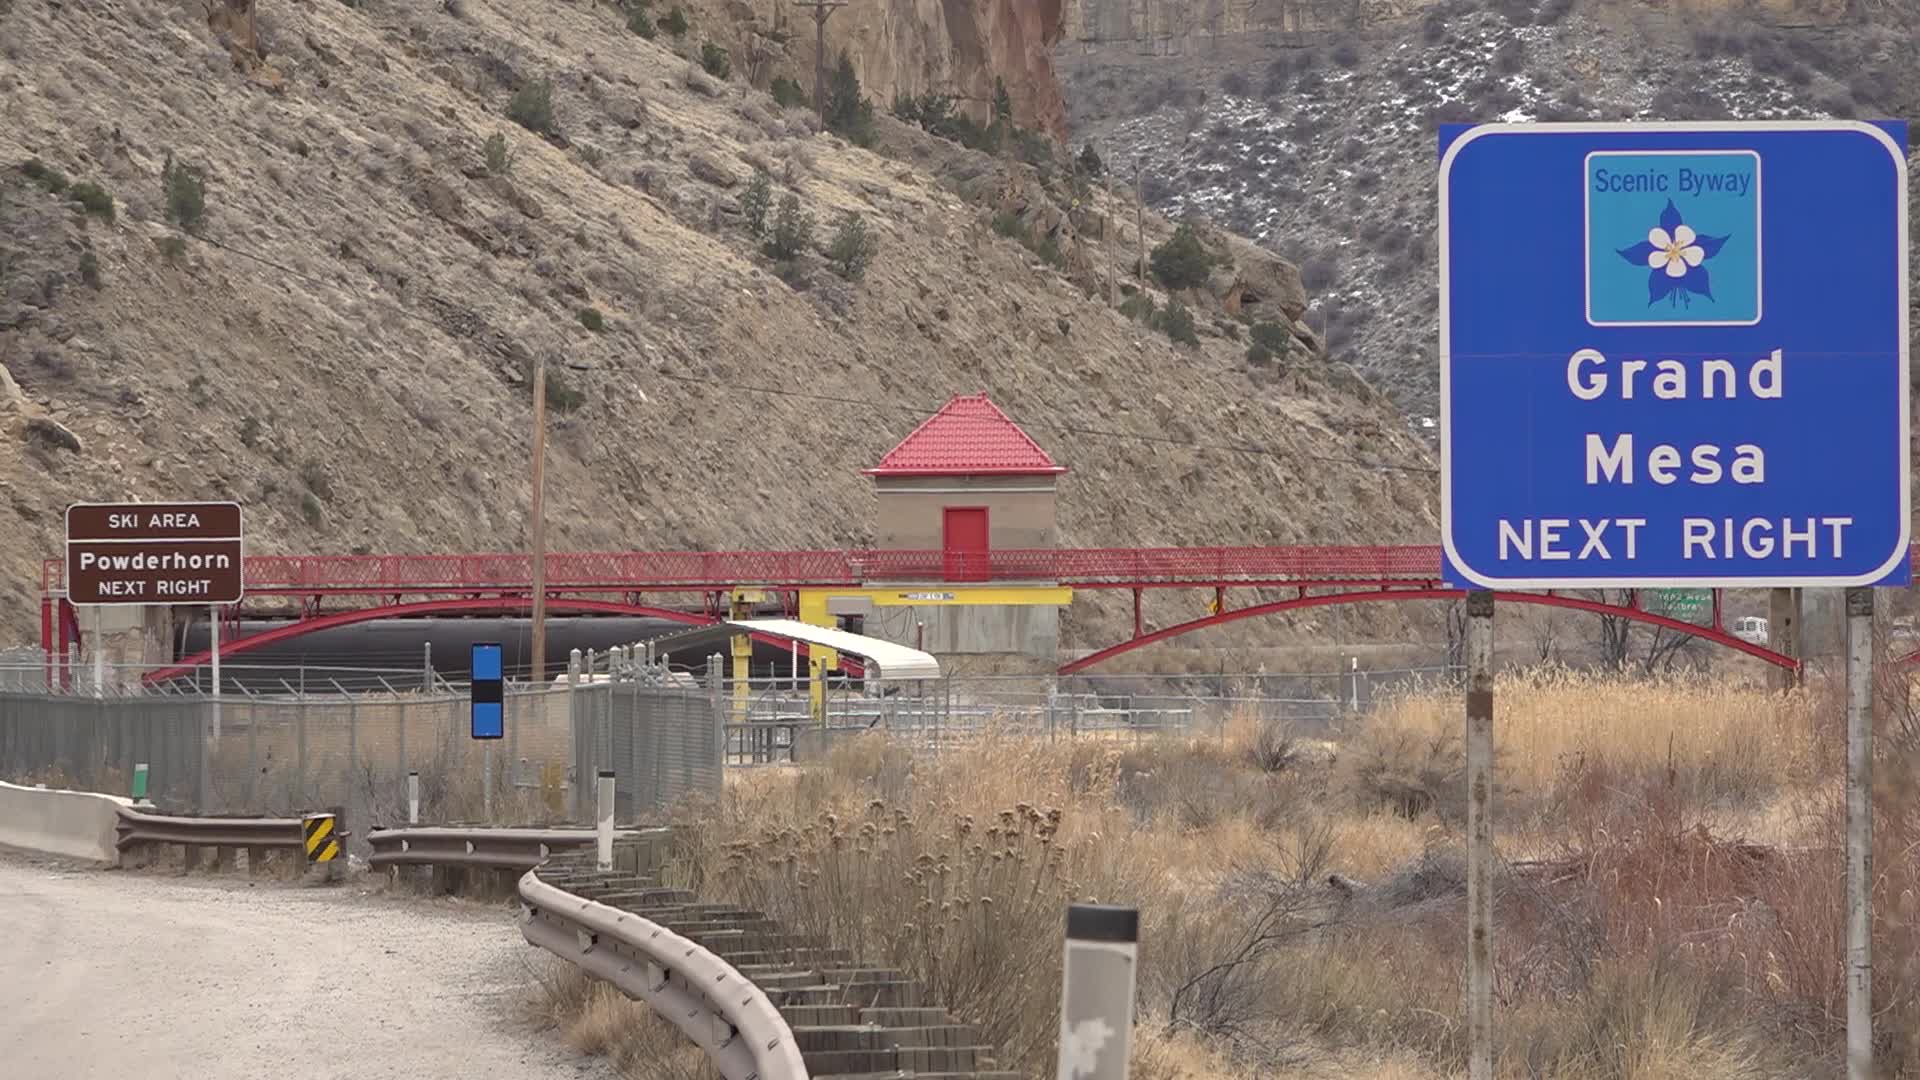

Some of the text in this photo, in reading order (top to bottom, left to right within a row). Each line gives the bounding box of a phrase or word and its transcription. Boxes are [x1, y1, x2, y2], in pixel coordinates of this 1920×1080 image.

[1595, 168, 1751, 197] Scenic Byway
[1568, 349, 1782, 400] Grand
[1586, 434, 1764, 484] Mesa
[109, 514, 200, 528] SKI AREA
[1499, 518, 1852, 560] NEXT RIGHT
[81, 552, 229, 570] Powderhorn
[99, 580, 211, 594] NEXT RIGHT
